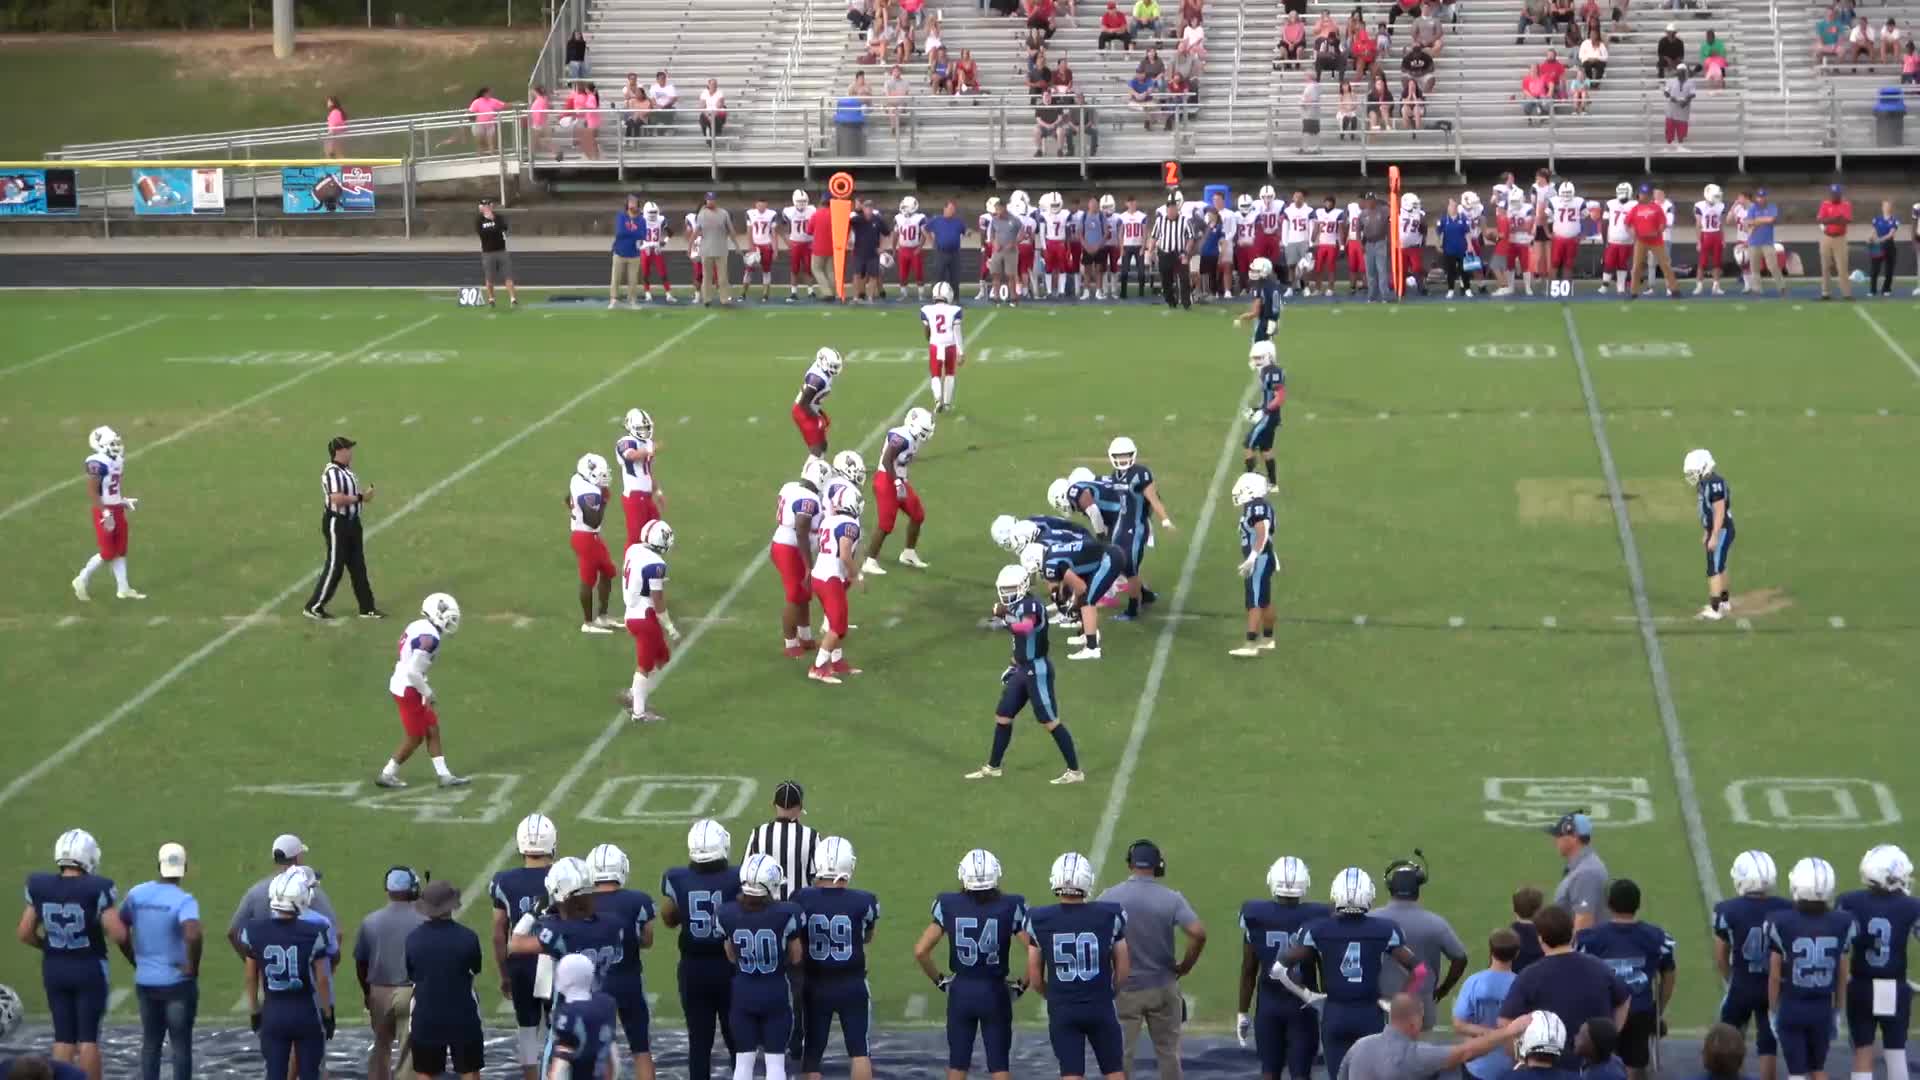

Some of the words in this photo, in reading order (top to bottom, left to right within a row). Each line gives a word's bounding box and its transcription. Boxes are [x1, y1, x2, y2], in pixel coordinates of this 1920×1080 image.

[1166, 162, 1178, 184] 2
[753, 220, 768, 235] 17
[1053, 222, 1061, 236] 7
[1557, 207, 1577, 222] 72
[459, 288, 477, 305] 30
[1550, 279, 1571, 297] 50
[935, 314, 947, 334] 2
[41, 902, 91, 949] 52
[807, 913, 853, 961] 69
[954, 917, 999, 966] 54
[1867, 917, 1892, 967] 3
[263, 944, 301, 991] 21
[733, 928, 779, 974] 30
[1052, 932, 1100, 982] 50
[1339, 941, 1364, 983] 4
[1792, 936, 1838, 987] 25
